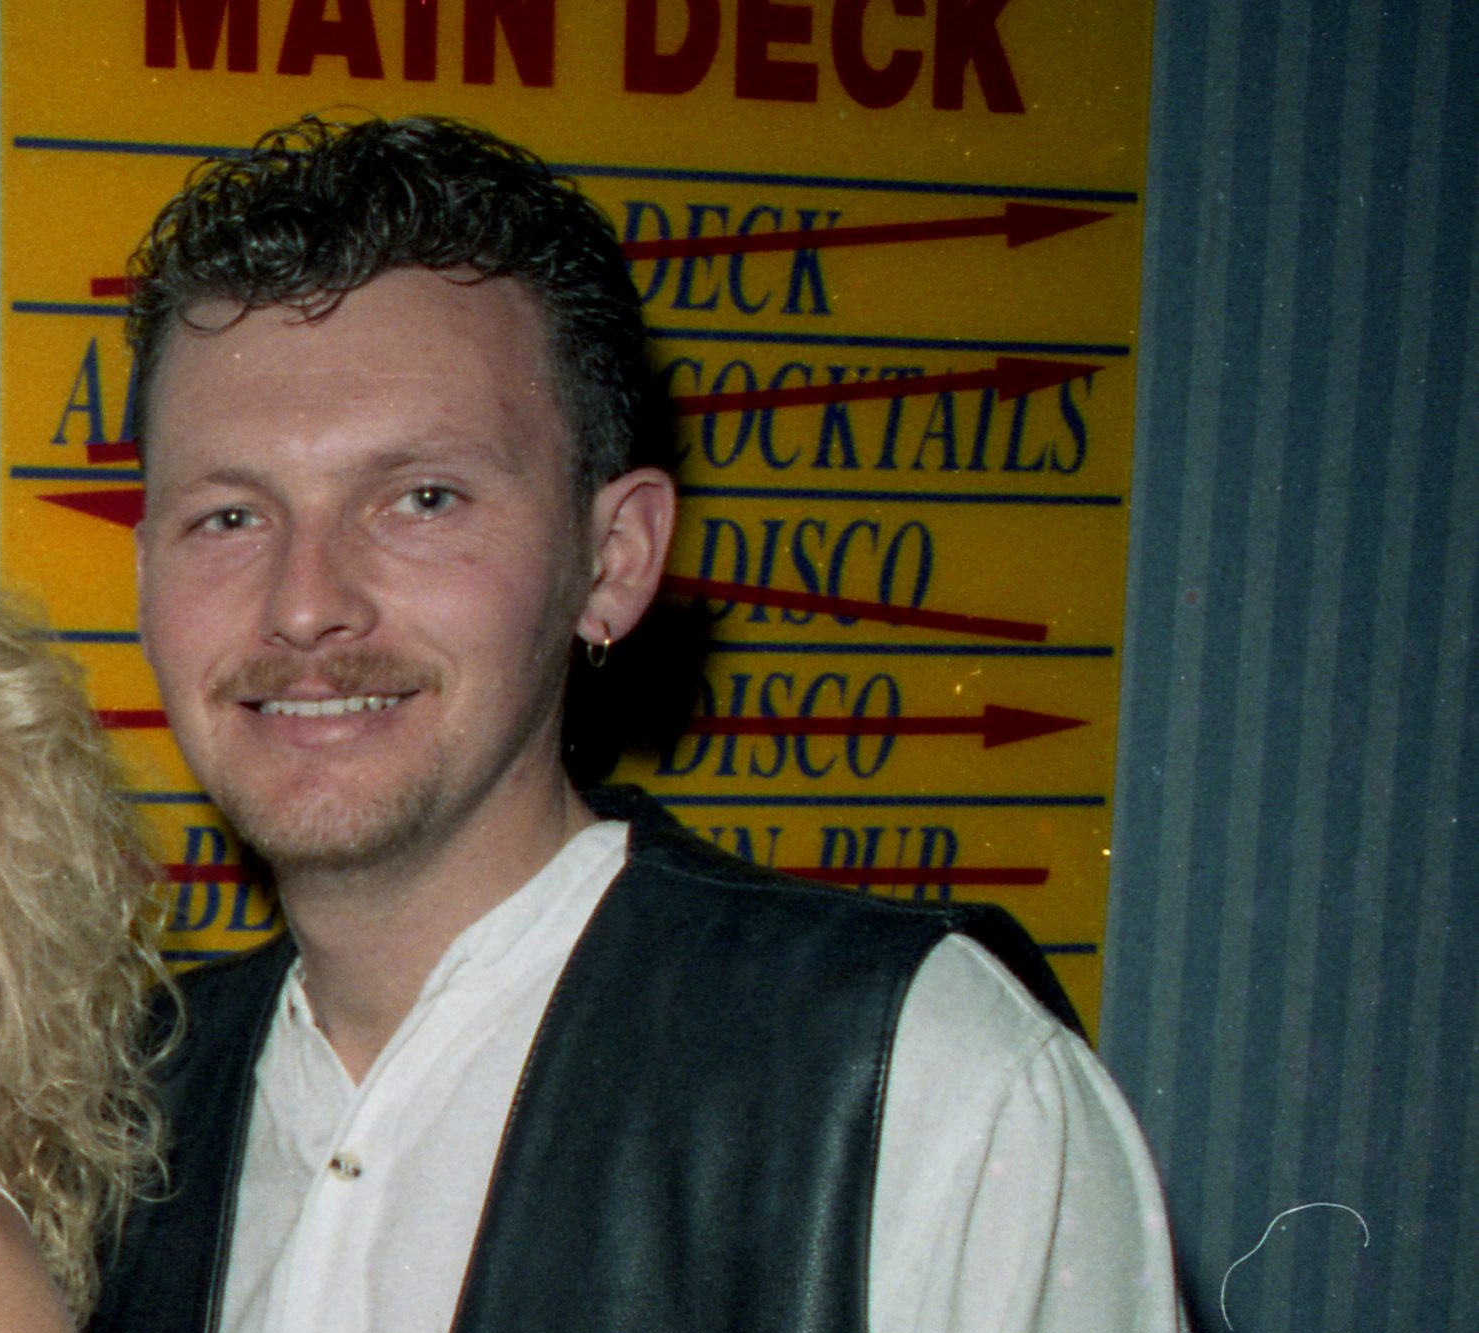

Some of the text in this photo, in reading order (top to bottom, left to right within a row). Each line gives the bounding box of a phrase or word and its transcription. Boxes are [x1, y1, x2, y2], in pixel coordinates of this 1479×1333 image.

[144, 0, 1025, 114] MAIN DECK
[623, 201, 842, 316] DECK
[688, 518, 933, 626] DISCO
[653, 672, 901, 779] DISCO
